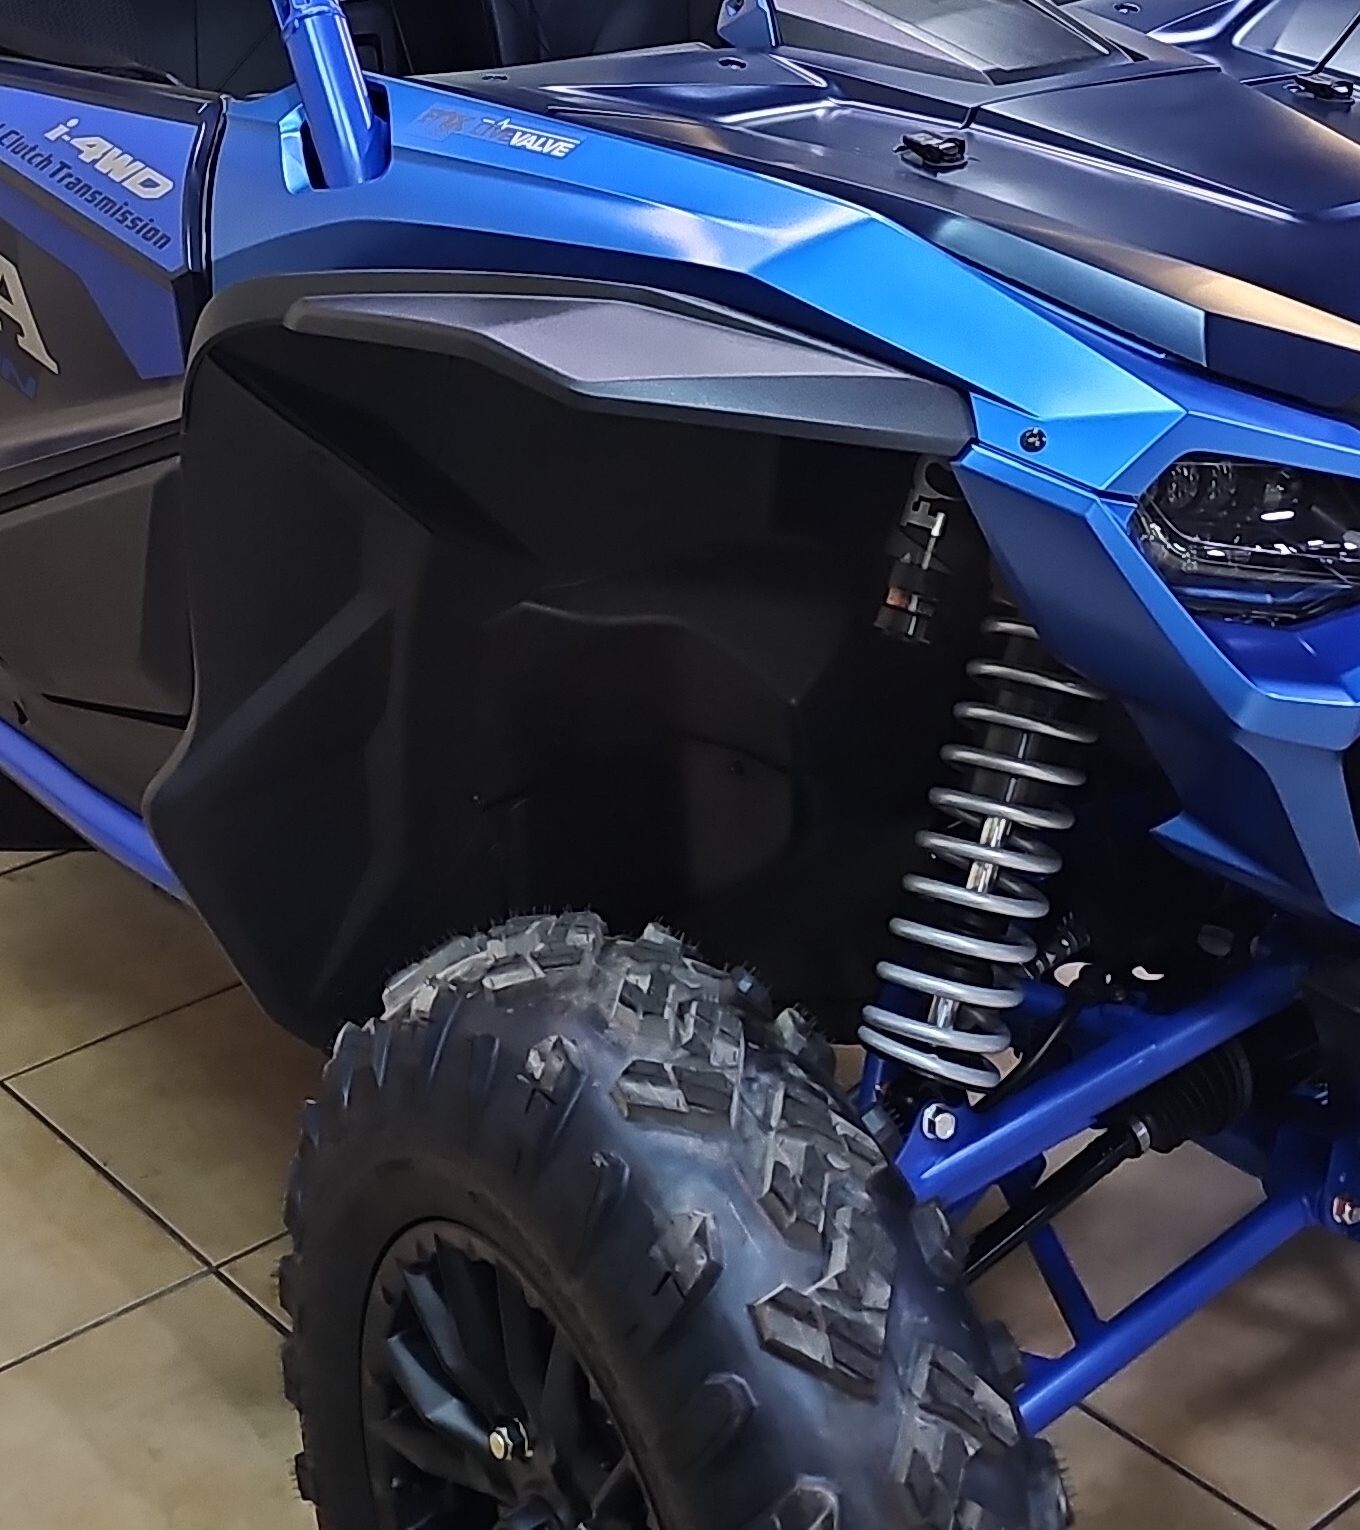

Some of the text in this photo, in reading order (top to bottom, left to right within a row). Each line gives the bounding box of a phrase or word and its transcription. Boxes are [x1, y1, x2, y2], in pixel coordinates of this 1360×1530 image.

[43, 117, 175, 200] i-4WD
[508, 130, 577, 158] VALVE
[48, 160, 173, 251] Transmission
